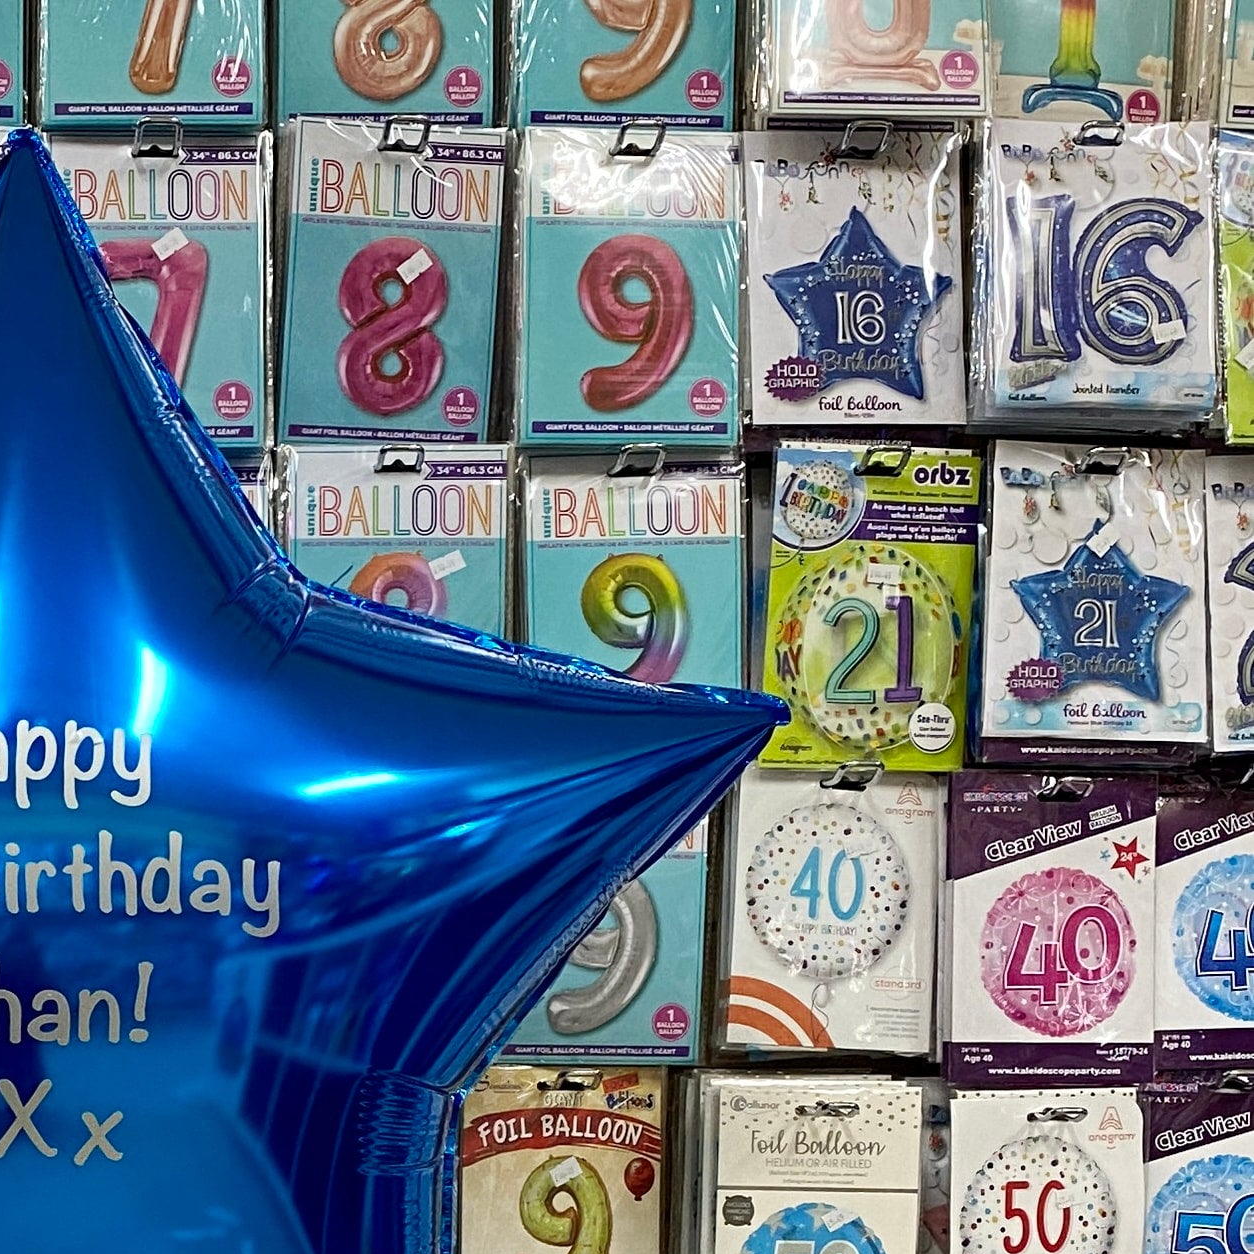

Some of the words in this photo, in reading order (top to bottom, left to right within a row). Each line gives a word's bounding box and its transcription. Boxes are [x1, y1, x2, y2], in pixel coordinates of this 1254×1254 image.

[461, 149, 484, 159] 86.3
[485, 150, 502, 160] CM
[74, 169, 248, 221] BALLOON
[320, 161, 491, 222] BALLOON
[835, 290, 887, 345] 16
[769, 377, 820, 388] GRAPHIC
[777, 364, 817, 377] HOLO
[819, 397, 843, 411] foil
[847, 397, 902, 411] balloon
[914, 463, 971, 486] orbz
[306, 485, 316, 536] unique
[319, 484, 492, 536] BALLOON
[555, 484, 727, 537] BALLOON
[1073, 598, 1120, 649] 21
[823, 596, 923, 705] 21
[1009, 678, 1060, 689] GRAPHIC
[1018, 665, 1057, 678] HOLO
[1063, 703, 1088, 719] foil
[1091, 703, 1147, 719] balloon
[885, 807, 934, 818] anagram
[986, 835, 1034, 861] Clear
[1034, 820, 1082, 845] View
[1173, 830, 1221, 851] Clear
[790, 846, 865, 921] 40
[1003, 905, 1122, 1007] 40
[963, 1055, 981, 1063] Age
[982, 1054, 994, 1063] 40
[543, 1091, 585, 1107] GIANT
[477, 1119, 533, 1148] FOIL
[541, 1115, 643, 1146] BALLOON
[750, 1130, 788, 1155] Foil
[795, 1130, 887, 1156] Balloon
[1156, 1126, 1205, 1151] Clear
[1205, 1112, 1251, 1137] View
[765, 1158, 805, 1168] HELIUM
[806, 1158, 821, 1168] OR
[822, 1159, 839, 1168] AIR
[840, 1159, 873, 1169] FILLED
